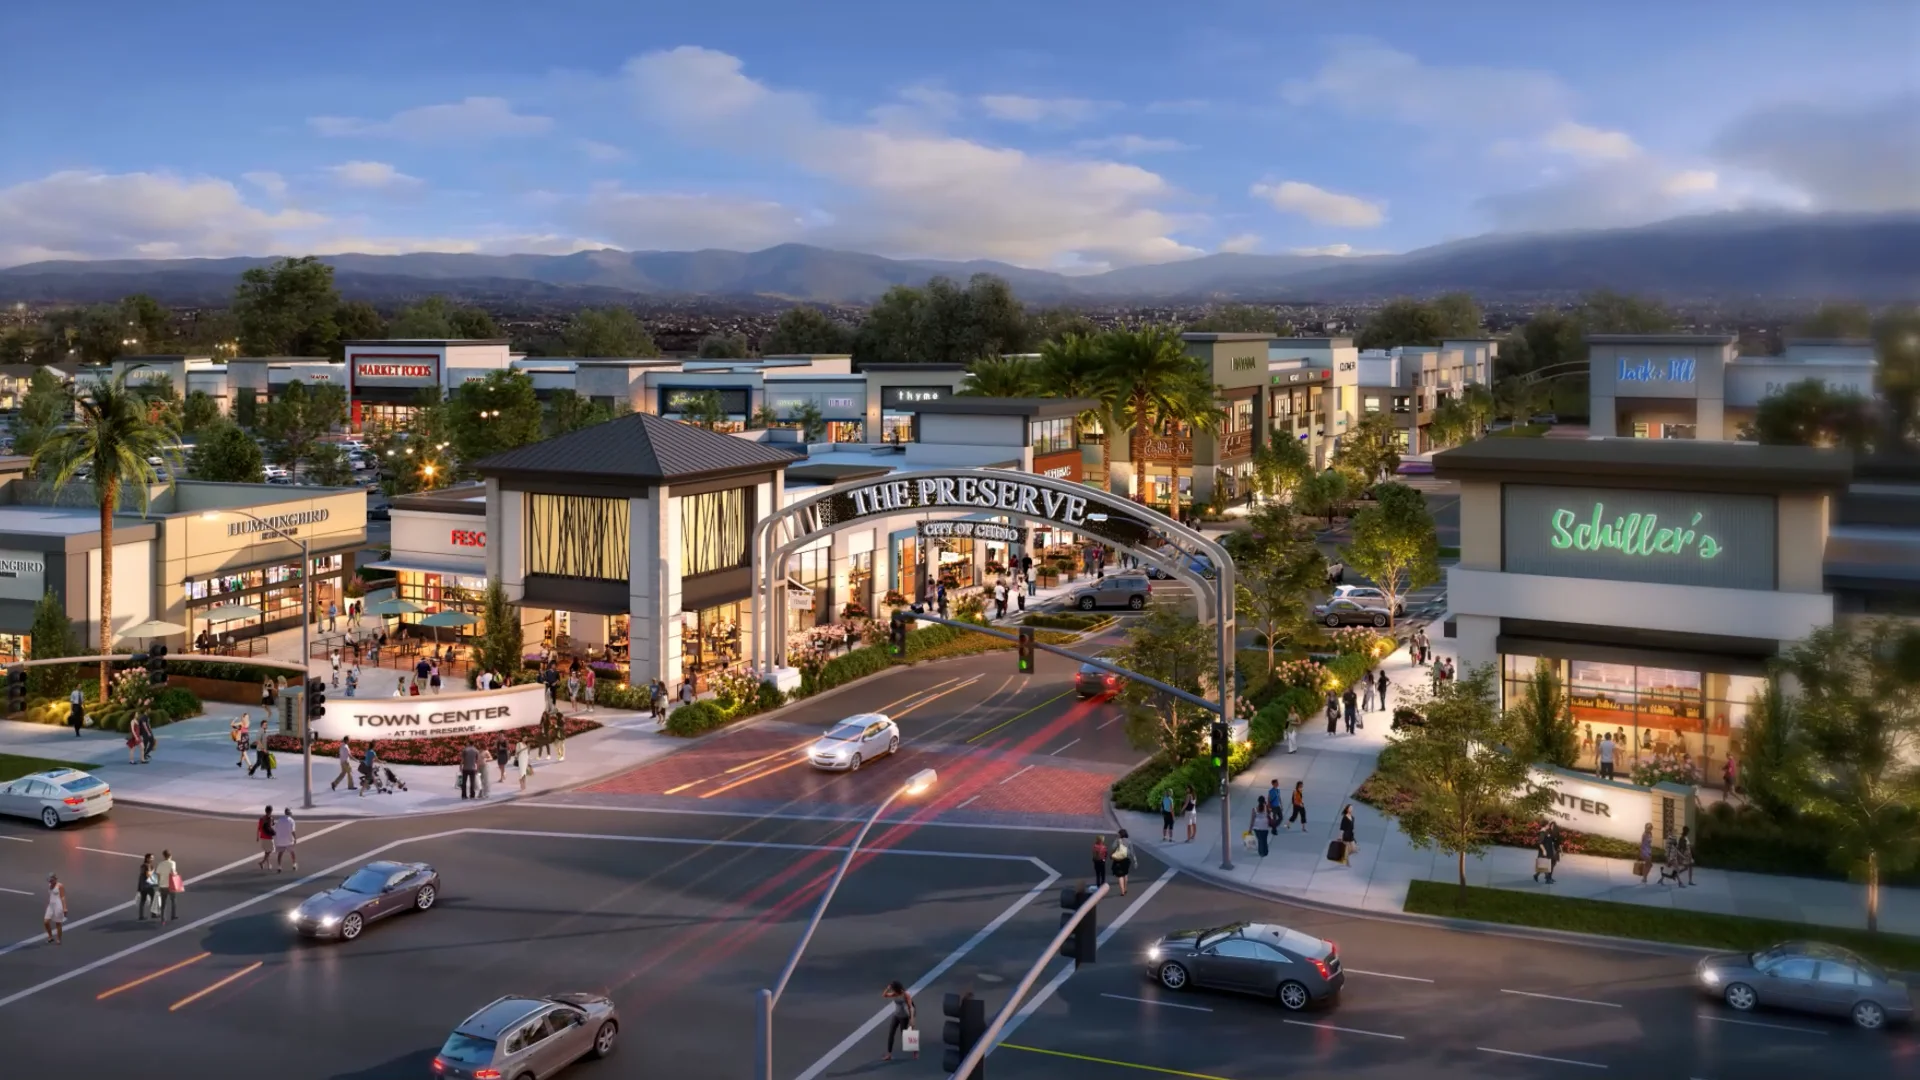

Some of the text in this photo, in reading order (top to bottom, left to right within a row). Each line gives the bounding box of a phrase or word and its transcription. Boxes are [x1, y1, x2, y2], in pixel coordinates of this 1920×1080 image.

[358, 364, 431, 377] MARKET FOODS
[1619, 358, 1656, 381] Jack
[899, 391, 939, 401] thyme
[850, 477, 1087, 526] THE PRESERVE
[227, 508, 329, 537] HUMMINGBIRD
[924, 522, 1018, 541] CITY OF CHINO
[1551, 502, 1722, 558] Schiller's
[353, 705, 511, 727] TOWN CENTER
[429, 725, 476, 735] PRESERVE
[1526, 783, 1611, 818] CNTER
